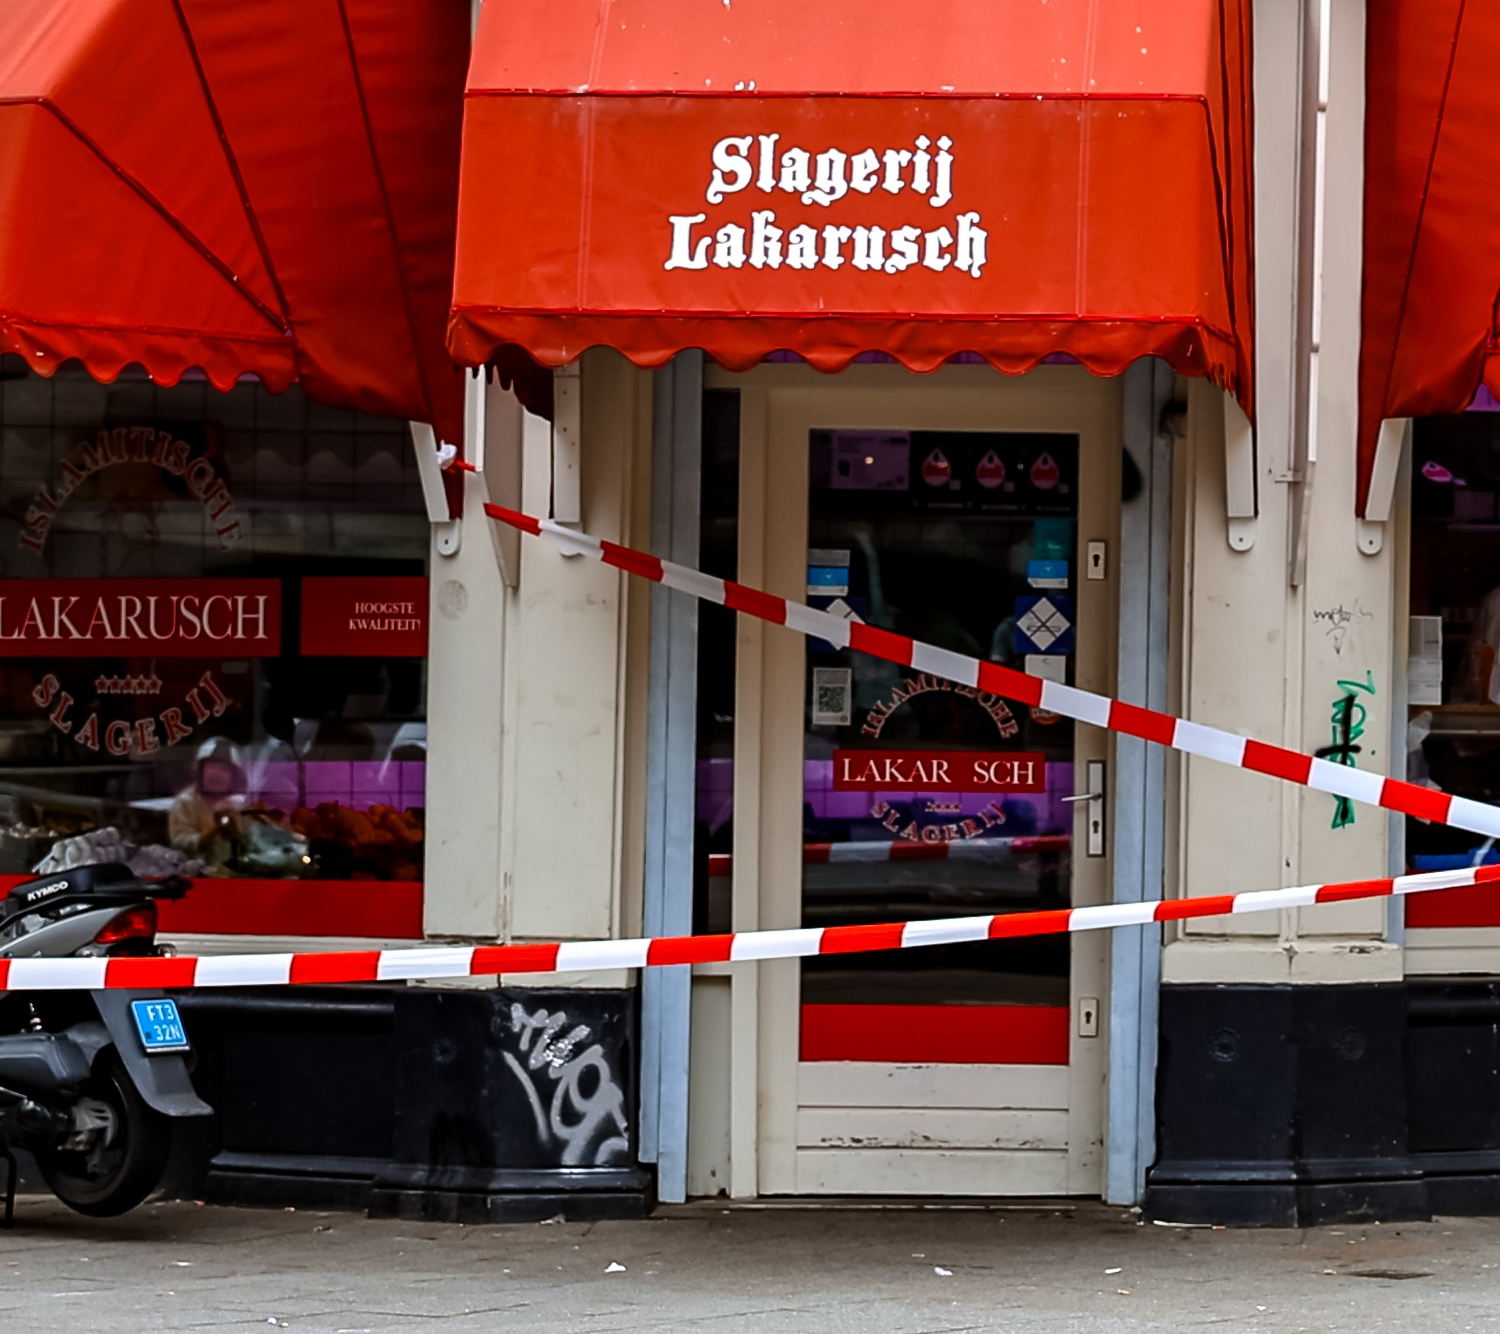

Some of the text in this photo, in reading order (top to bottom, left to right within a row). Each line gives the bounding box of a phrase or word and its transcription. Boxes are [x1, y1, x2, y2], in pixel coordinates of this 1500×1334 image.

[705, 133, 954, 207] Slagerij
[664, 210, 988, 278] Lakarusch
[18, 426, 243, 554] ISLAMITISCHE
[355, 602, 416, 614] HOOGSTE
[31, 669, 233, 757] SLAGERIJ
[870, 800, 1007, 845] SLAGERIJ
[27, 880, 69, 902] KYMCO
[146, 1004, 175, 1021] FT3
[153, 1024, 181, 1042] 32N
